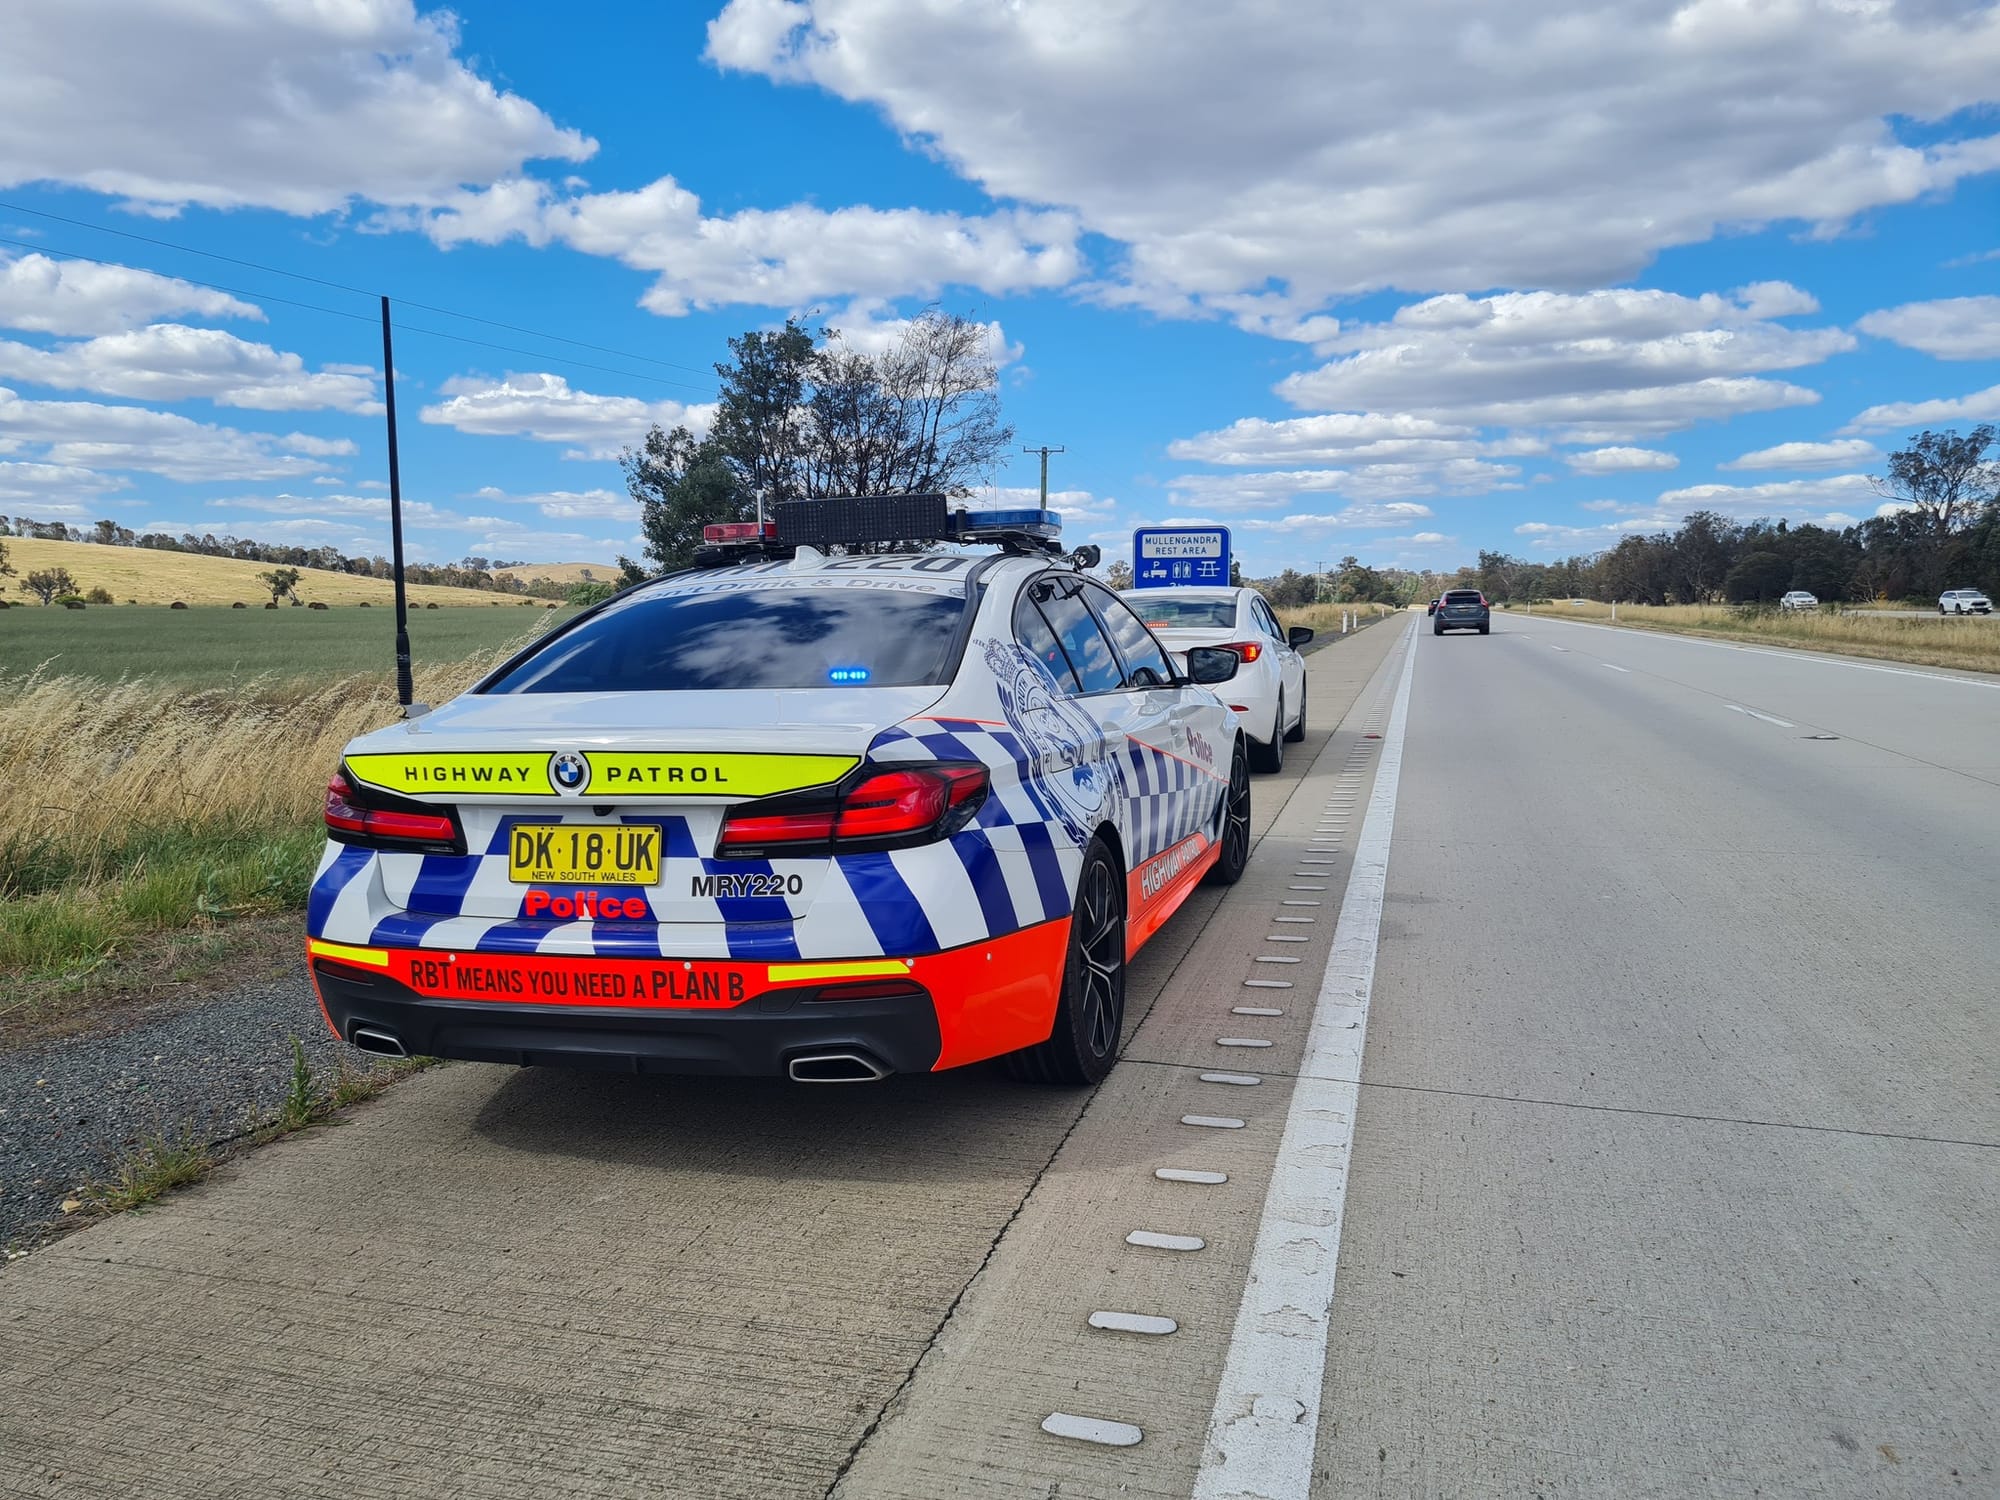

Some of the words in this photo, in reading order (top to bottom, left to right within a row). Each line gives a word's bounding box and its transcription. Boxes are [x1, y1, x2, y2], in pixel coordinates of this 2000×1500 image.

[1145, 536, 1218, 545] MULLENGANDRA
[1155, 546, 1177, 555] REST
[1182, 546, 1207, 555] AREA
[823, 555, 968, 572] 220
[1153, 560, 1160, 569] P
[712, 579, 799, 592] Drink
[810, 579, 833, 587] &
[846, 579, 936, 592] Drive
[1186, 726, 1212, 765] Police
[405, 766, 530, 781] HIGHWAY
[607, 767, 728, 782] PATROL
[515, 832, 554, 868] DK
[571, 833, 603, 870] 18
[616, 833, 655, 871] UK
[532, 871, 555, 880] NEW
[560, 872, 595, 881] SOUTH
[601, 873, 636, 881] WALES
[1141, 845, 1181, 900] HIGHWAY
[691, 874, 803, 897] MRY220
[525, 890, 646, 918] Police
[410, 960, 451, 989] RBT
[456, 967, 523, 993] MEANS
[528, 970, 568, 996] YOU
[574, 973, 626, 998] NEED
[633, 974, 646, 999] A
[652, 971, 720, 1000] PLAN
[728, 972, 745, 1001] B
